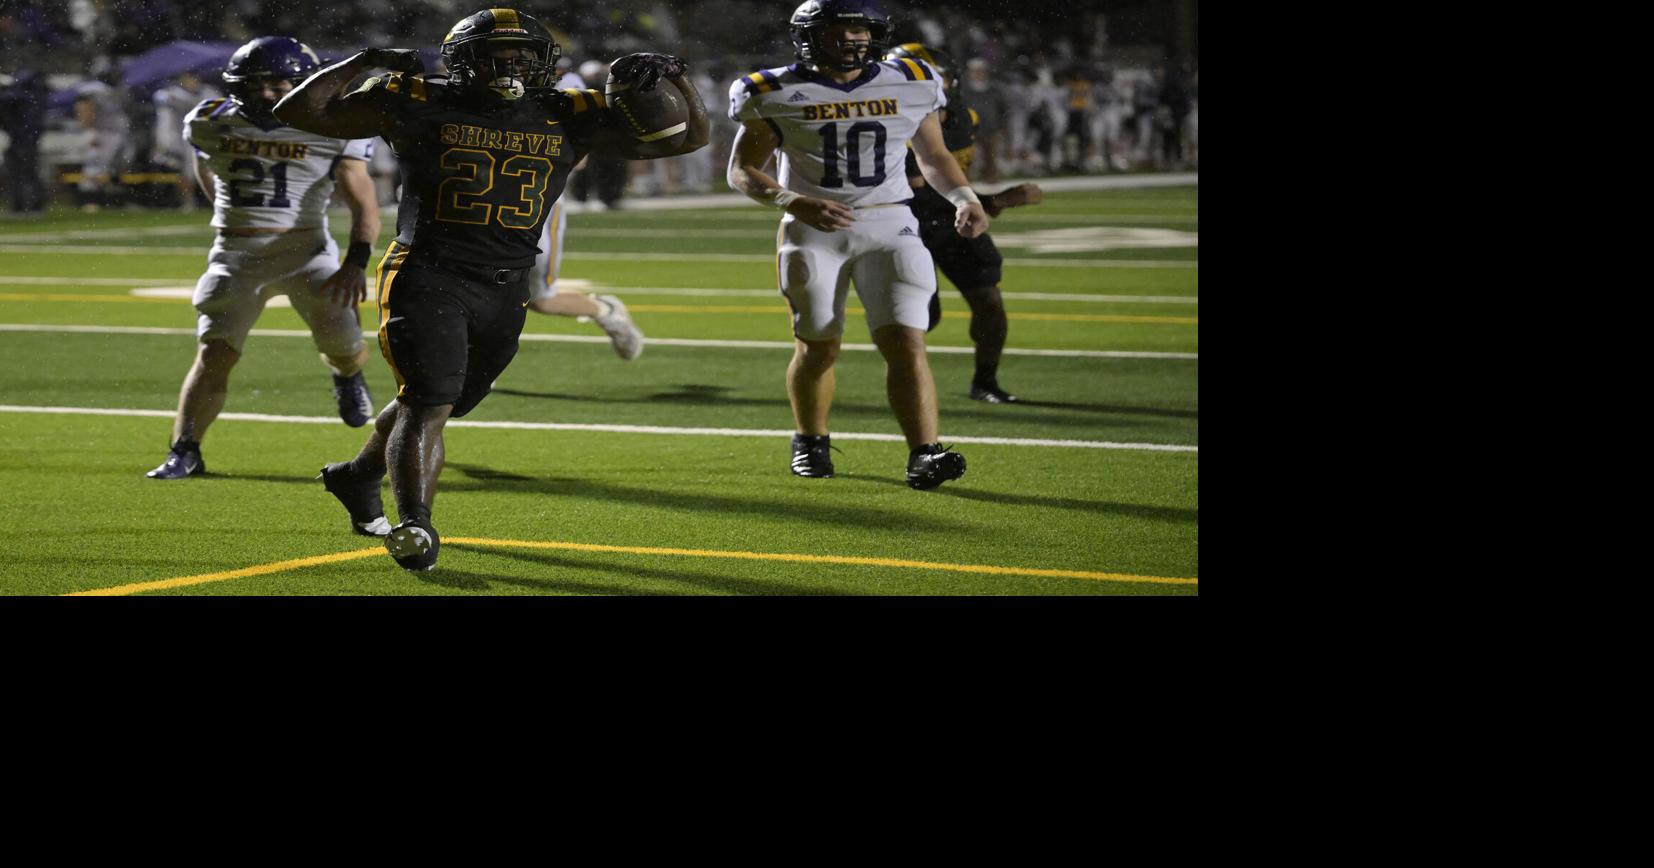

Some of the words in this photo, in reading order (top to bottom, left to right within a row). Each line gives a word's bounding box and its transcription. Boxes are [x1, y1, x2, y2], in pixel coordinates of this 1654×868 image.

[802, 98, 898, 121] BENTON
[440, 123, 562, 156] SHREVE
[818, 120, 887, 187] 10
[229, 158, 291, 208] 21
[435, 147, 554, 229] 23
